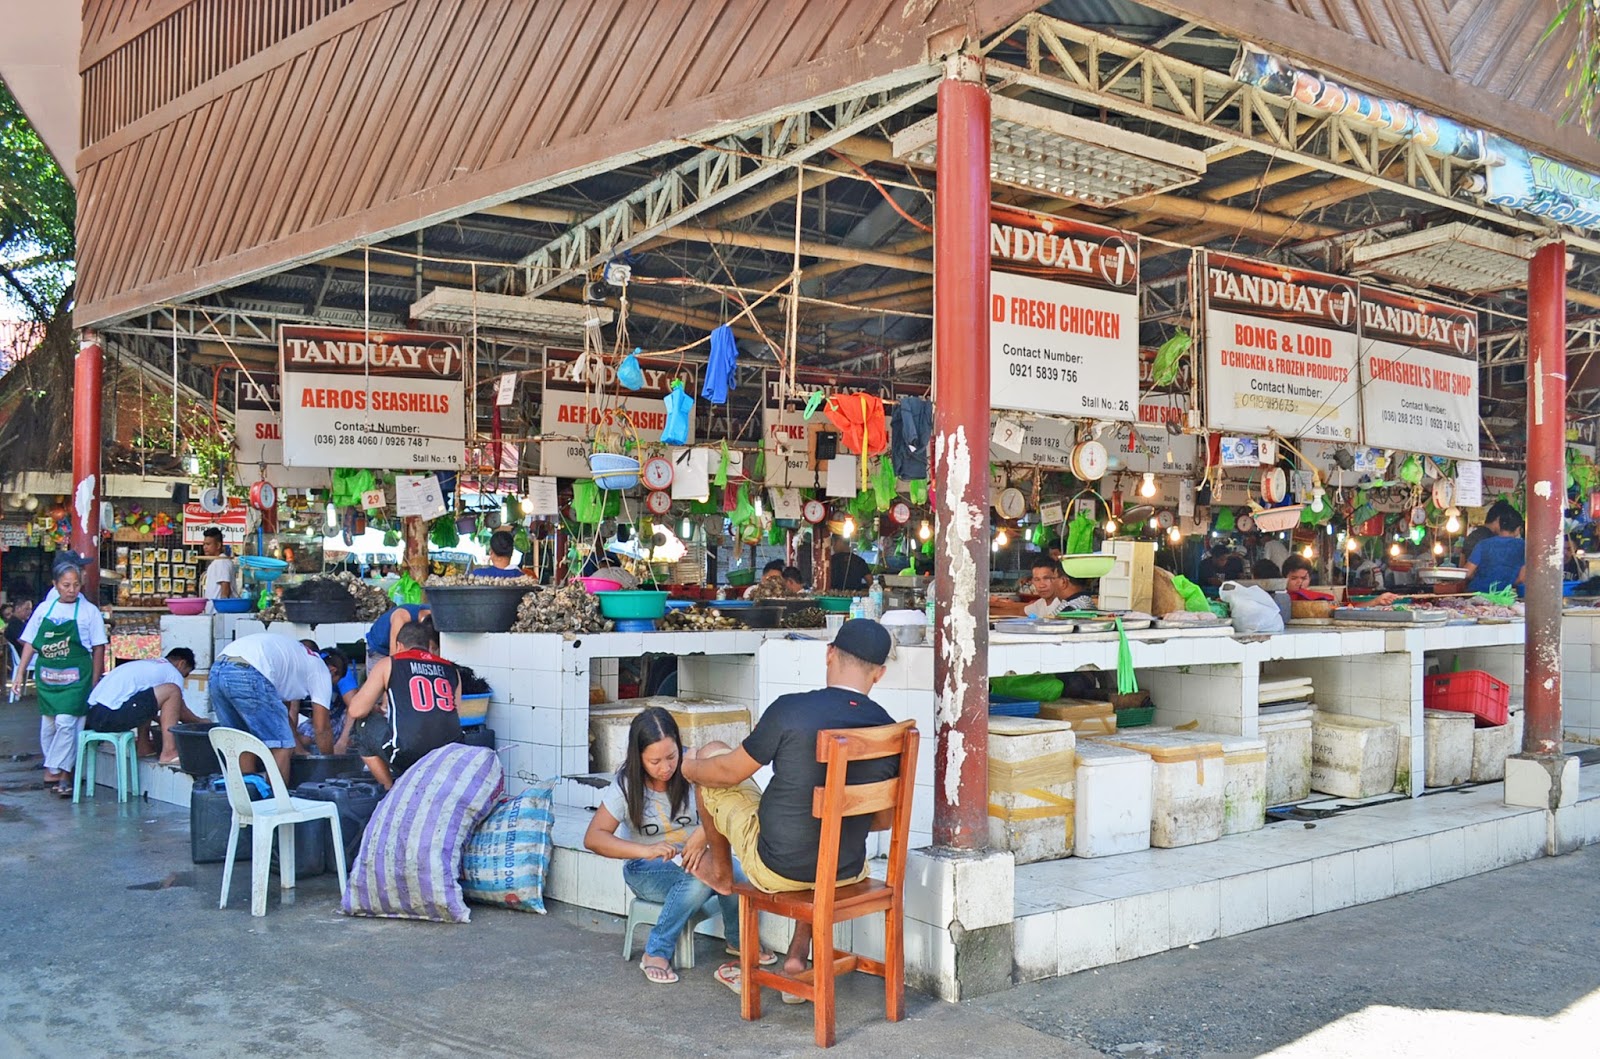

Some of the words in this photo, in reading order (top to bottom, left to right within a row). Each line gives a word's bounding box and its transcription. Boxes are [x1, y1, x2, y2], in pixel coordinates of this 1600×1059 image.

[990, 223, 1099, 273] NDUAY
[1209, 267, 1328, 316] TANDUAY
[1010, 296, 1056, 331] FRESH
[1059, 304, 1120, 340] CHICKEN
[1360, 300, 1453, 344] TANDUAY
[1234, 323, 1277, 352] BONG
[1281, 333, 1294, 353] &
[1297, 334, 1332, 359] LOID
[286, 338, 427, 369] TANDUAY
[1003, 343, 1042, 360] Contact
[1043, 348, 1084, 365] Number:
[548, 358, 666, 391] TANDAY
[1009, 362, 1032, 378] 0921
[1035, 364, 1058, 380] 5839
[1061, 368, 1078, 383] 756
[1220, 349, 1266, 373] D'CHICKEN
[1268, 358, 1275, 373] &
[1276, 357, 1305, 378] FROZEN
[1306, 362, 1348, 383] PRODUCTS
[1369, 356, 1431, 389] CHRISHEIL'S
[1432, 368, 1451, 393] MEAT
[1452, 373, 1471, 397] SHOP
[1250, 378, 1286, 394] Contact
[1287, 383, 1323, 399] Number:
[300, 387, 367, 411] AEROS
[371, 389, 450, 414] SEASHELLS
[1081, 395, 1100, 409] Stall
[1101, 397, 1117, 411] No.:
[1118, 399, 1129, 412] 26
[1400, 398, 1424, 411] Contact
[1424, 402, 1448, 416] Number:
[1138, 403, 1159, 423] MEAT
[1381, 409, 1397, 424] (036)
[1397, 412, 1408, 424] 288
[1409, 414, 1423, 426] 2153
[377, 422, 421, 434] Number:
[1005, 428, 1013, 442] 9
[1315, 424, 1330, 437] Stall
[1344, 427, 1351, 439] 8
[314, 433, 337, 447] (036)
[338, 434, 355, 446] 288
[357, 435, 378, 446] 4060
[385, 436, 406, 447] 0926
[407, 436, 423, 447] 748
[424, 437, 430, 447] 7
[1030, 435, 1042, 446] 698
[1043, 437, 1060, 448] 1878
[412, 453, 429, 463] Stall
[447, 454, 457, 463] 19
[787, 460, 803, 469] 0947
[1032, 452, 1047, 463] Stall
[367, 493, 380, 505] 29
[408, 675, 455, 712] 09
[504, 829, 517, 869] GROWER
[504, 870, 516, 889] HOG
